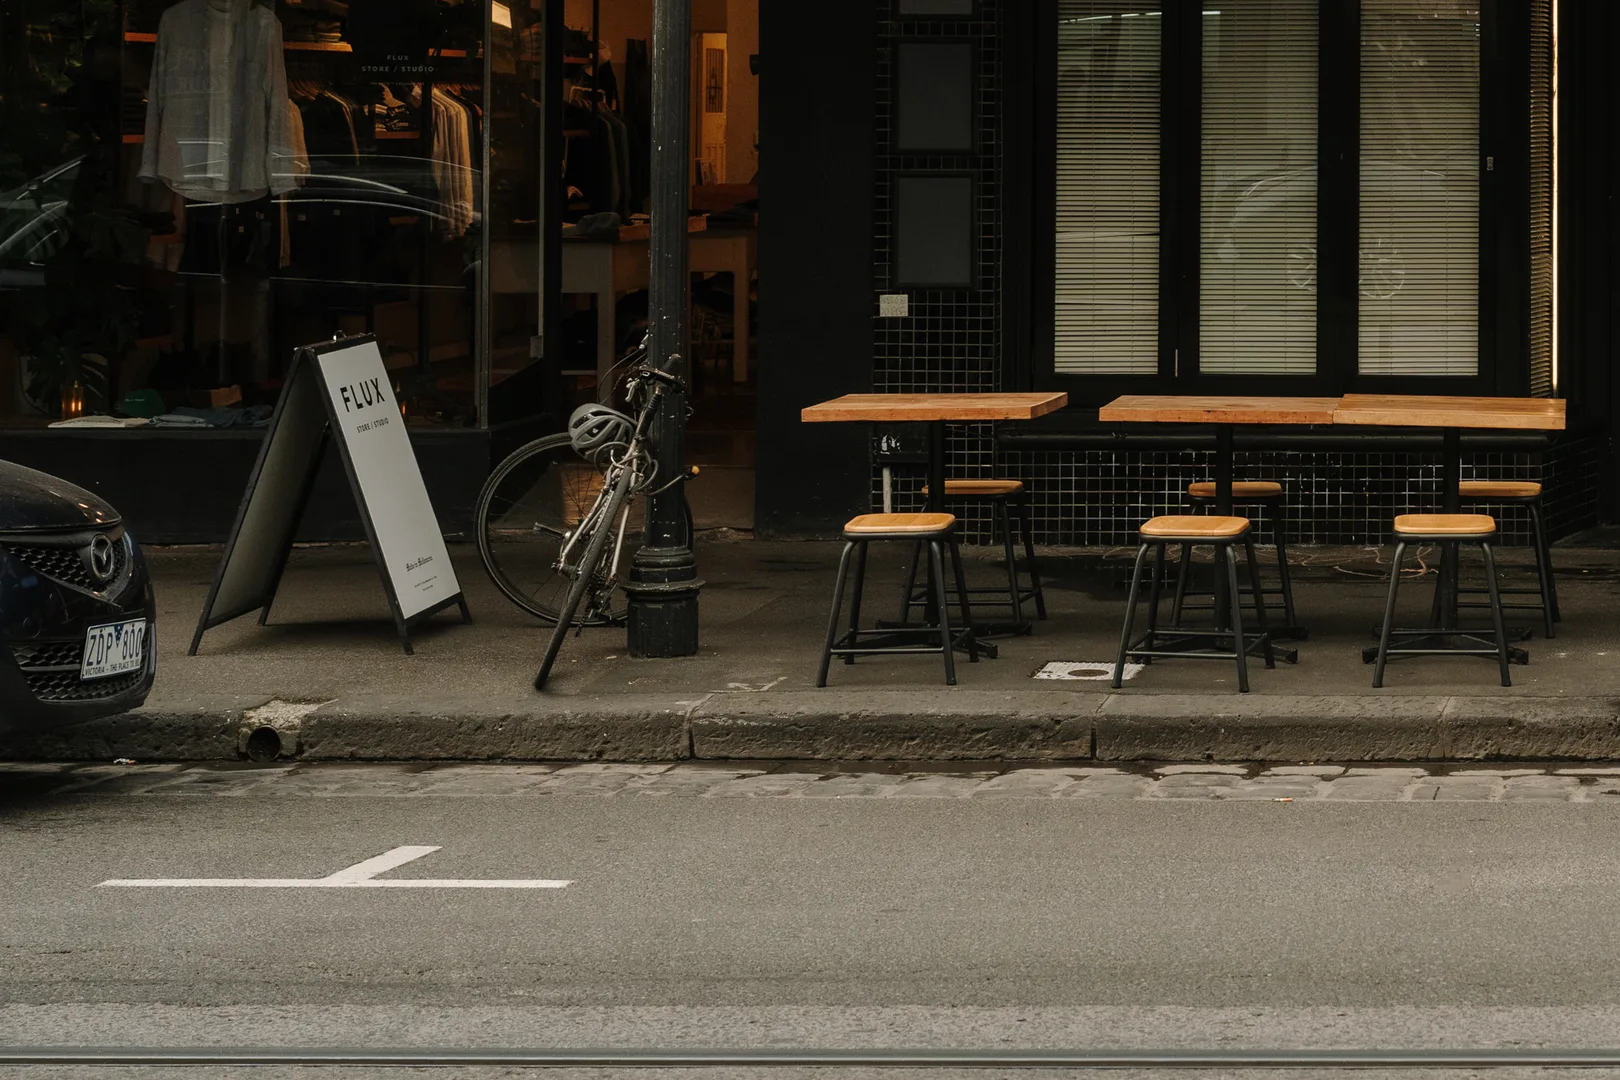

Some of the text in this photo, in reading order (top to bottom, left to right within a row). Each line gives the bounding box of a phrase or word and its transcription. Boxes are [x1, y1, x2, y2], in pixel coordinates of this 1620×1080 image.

[340, 377, 385, 413] FLUX
[357, 423, 371, 433] STORE
[373, 417, 389, 428] STUDIO
[86, 627, 142, 666] ZDP 800
